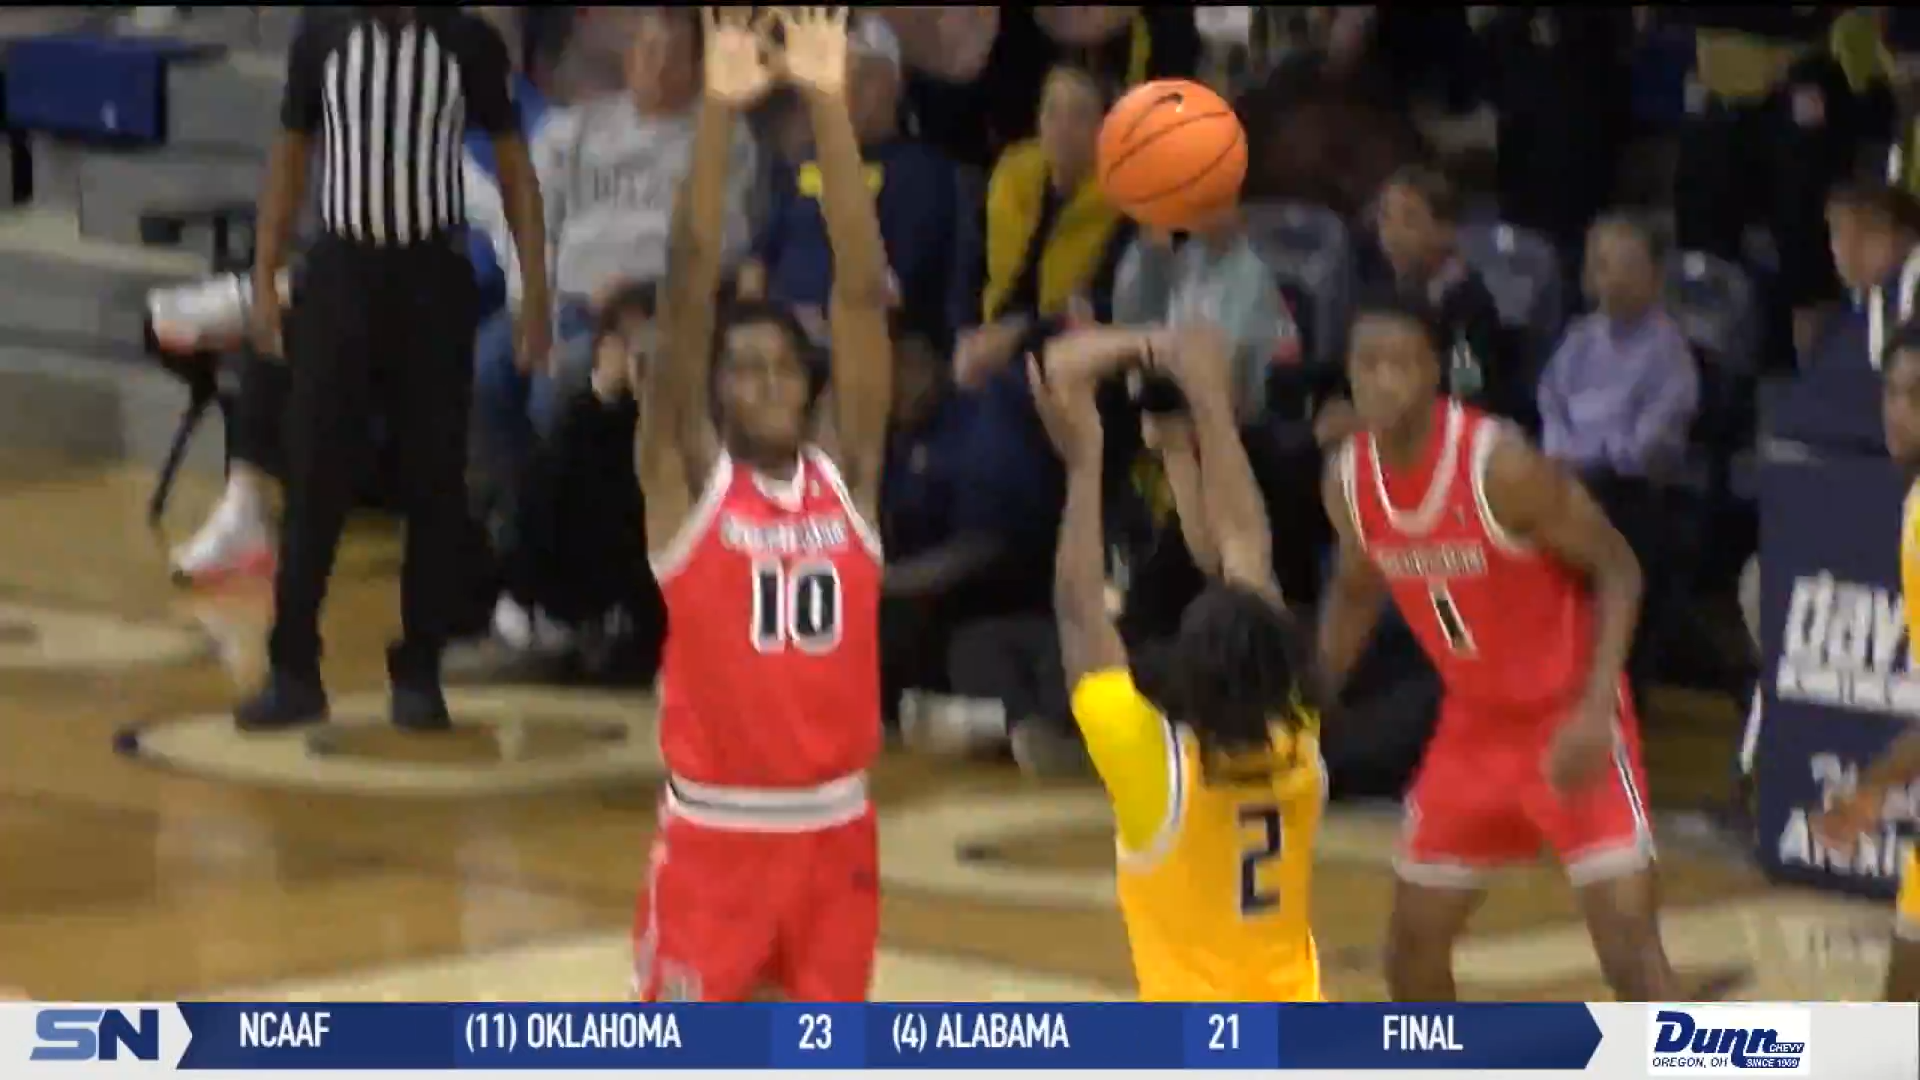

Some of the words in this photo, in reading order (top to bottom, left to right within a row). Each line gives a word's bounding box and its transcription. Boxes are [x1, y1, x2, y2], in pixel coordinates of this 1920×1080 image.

[750, 556, 844, 653] 10
[1428, 578, 1479, 660] 1
[1237, 803, 1284, 919] 2
